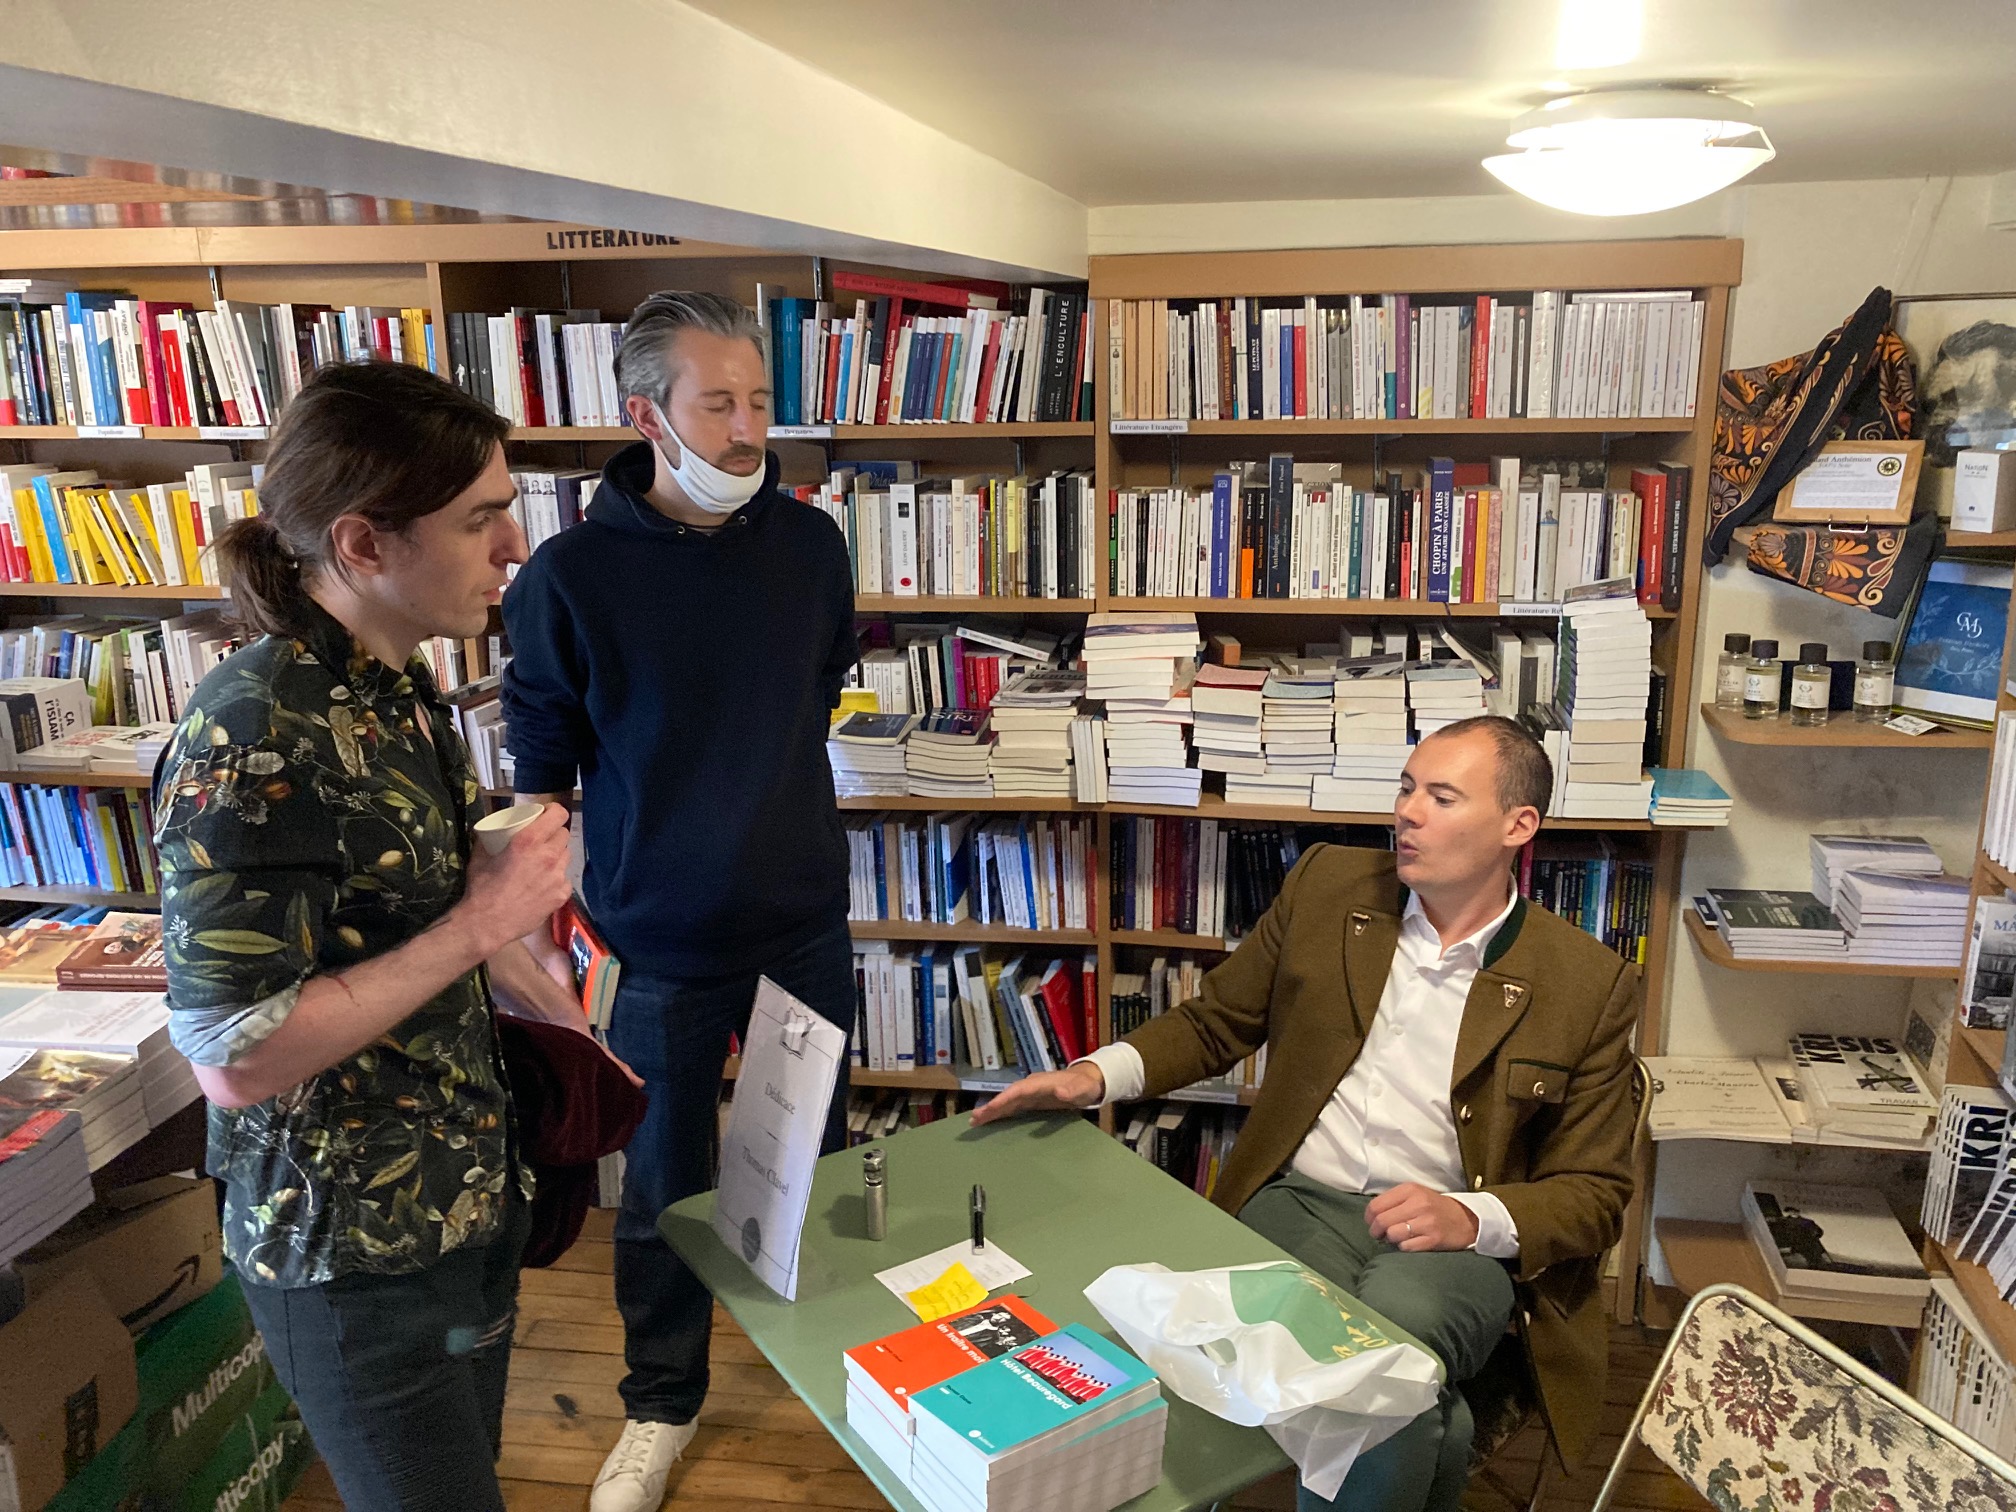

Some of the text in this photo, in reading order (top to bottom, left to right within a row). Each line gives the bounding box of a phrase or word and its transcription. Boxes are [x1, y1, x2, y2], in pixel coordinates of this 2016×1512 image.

[120, 310, 129, 336] ONFRAY
[1054, 300, 1070, 377] L'ENCULTURE
[887, 330, 896, 360] Garnison
[8, 506, 17, 531] SOCIETY
[1432, 491, 1443, 574] CHOPIN À PARIS
[64, 711, 75, 727] ÇA
[930, 712, 979, 722] SIRE
[764, 1082, 797, 1115] Dédicace
[741, 1144, 790, 1197] Thomas Clavel
[936, 1323, 988, 1365] Un traître mot
[171, 1330, 264, 1438] Multicop
[999, 1357, 1074, 1411] Hôtel Beauregard
[214, 1432, 284, 1512] lticopy
